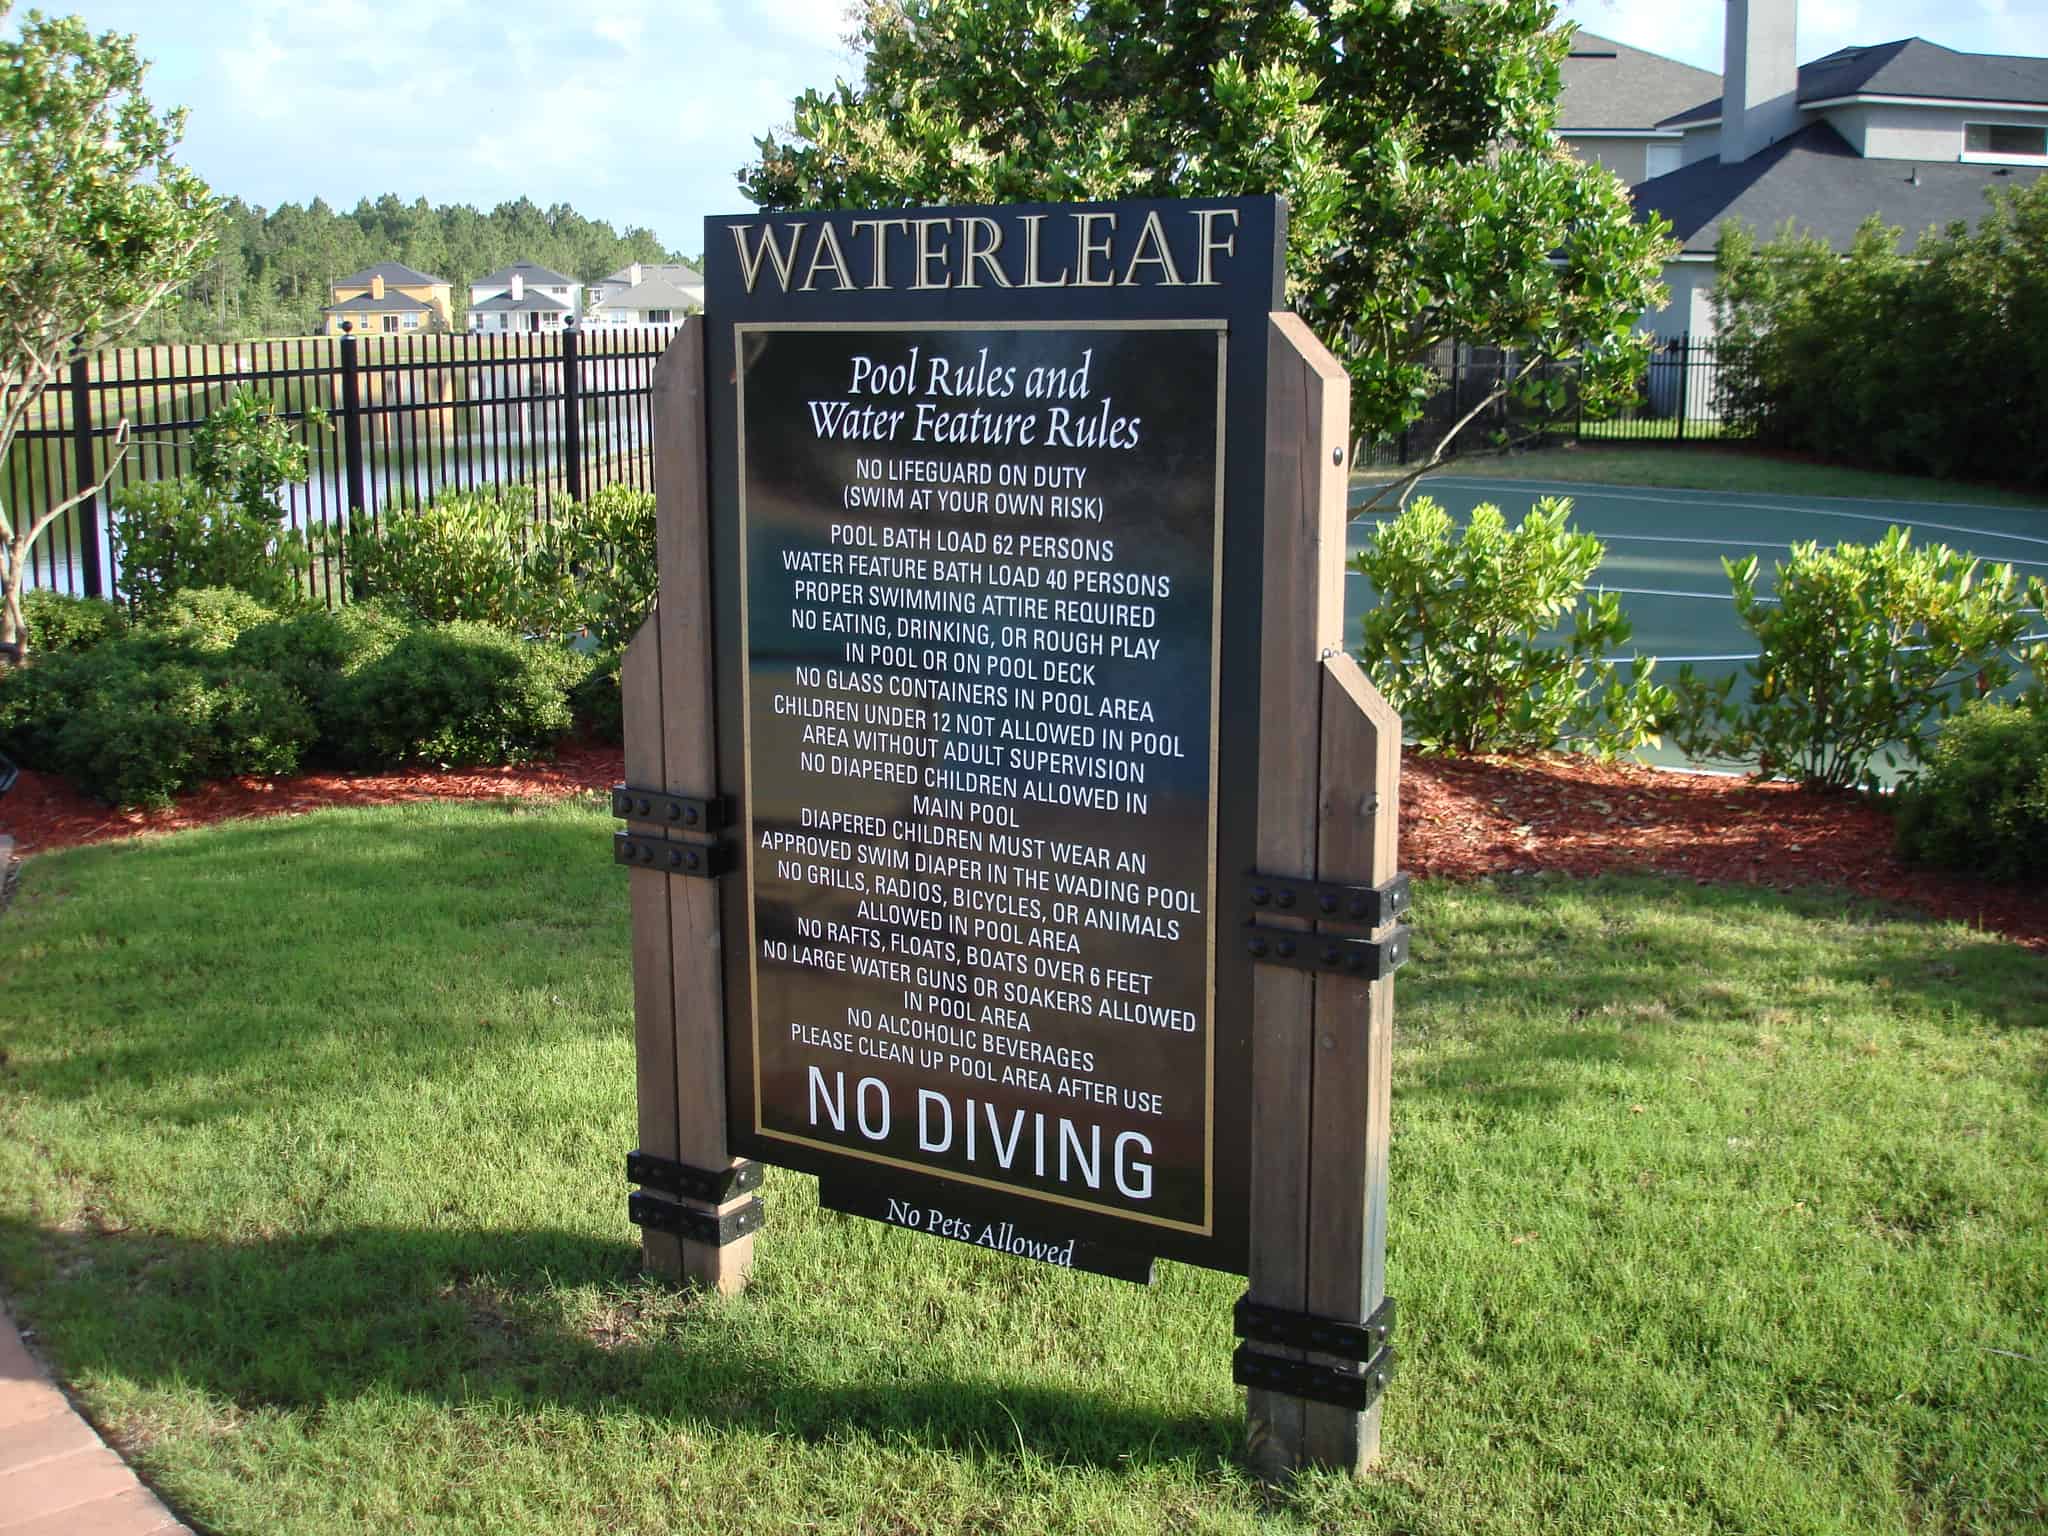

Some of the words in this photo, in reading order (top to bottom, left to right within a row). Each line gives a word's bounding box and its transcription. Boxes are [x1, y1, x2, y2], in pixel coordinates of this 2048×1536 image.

[729, 209, 1240, 293] WATERLEAF
[847, 345, 919, 396] Pool
[924, 346, 1017, 398] Rules
[1024, 347, 1093, 400] and
[807, 400, 905, 441] Water
[911, 403, 1036, 446] Feature
[1043, 396, 1141, 450] Rules
[856, 457, 882, 480] NO
[888, 459, 992, 485] LIFEGUARD
[998, 463, 1027, 487] ON
[1033, 465, 1087, 489] DUTY
[843, 484, 904, 509] (SWIM
[909, 488, 933, 510] AT
[936, 489, 989, 513] YOUR
[994, 492, 1044, 516] OWN
[1050, 495, 1104, 523] RISK)
[830, 523, 878, 547] POOL
[882, 526, 931, 550] BATH
[937, 529, 987, 554] LOAD
[992, 533, 1014, 556] 62
[1019, 534, 1114, 562] PERSONS
[781, 549, 844, 574] WATER
[848, 554, 927, 580] FEATURE
[933, 559, 982, 585] BATH
[988, 563, 1040, 588] LOAD
[1045, 568, 1067, 590] 40
[1073, 569, 1170, 598] PERSONS
[794, 579, 863, 605] PROPER
[868, 585, 976, 614] SWIMMING
[981, 594, 1049, 620] ATTIRE
[1054, 599, 1156, 628] REQUIRED
[791, 608, 817, 630] NO
[822, 610, 892, 640] EATING,
[897, 616, 995, 649] DRINKING,
[1001, 625, 1027, 649] OR
[1033, 628, 1103, 656] ROUGH
[1110, 635, 1161, 661] PLAY
[845, 641, 864, 663] IN
[870, 644, 918, 669] POOL
[922, 649, 947, 671] OR
[953, 651, 980, 675] ON
[986, 655, 1038, 681] POOL
[1043, 660, 1096, 686] DECK
[795, 665, 821, 688] NO
[826, 669, 883, 694] GLASS
[889, 675, 1008, 707] CONTAINERS
[1014, 687, 1035, 711] IN
[1041, 690, 1094, 717] POOL
[1098, 696, 1155, 723] AREA
[774, 694, 859, 722] CHILDREN
[864, 703, 926, 730] UNDER
[932, 711, 951, 733] 12
[956, 713, 996, 737] NOT
[999, 718, 1095, 748] ALLOWED
[1102, 727, 1123, 751] IN
[1130, 731, 1185, 758] POOL
[802, 723, 849, 748] AREA
[853, 729, 939, 759] WITHOUT
[943, 740, 1005, 767] ADULT
[1009, 747, 1145, 784] SUPERVISION
[800, 751, 825, 773] NO
[831, 755, 918, 785] DIAPERED
[924, 767, 1017, 798] CHILDREN
[1022, 779, 1119, 811] ALLOWED
[1126, 791, 1147, 815] IN
[913, 794, 963, 821] MAIN
[969, 801, 1020, 828] POOL
[801, 807, 886, 837] DIAPERED
[892, 820, 982, 852] CHILDREN
[989, 833, 1046, 860] MUST
[1049, 840, 1110, 870] WEAR
[1115, 850, 1146, 875] AN
[760, 830, 851, 861] APPROVED
[857, 844, 909, 871] SWIM
[915, 852, 982, 881] DIAPER
[987, 863, 1007, 885] IN
[1012, 866, 1050, 891] THE
[1054, 872, 1140, 904] WADING
[1146, 885, 1201, 914] POOL
[777, 859, 802, 881] NO
[807, 864, 870, 895] GRILLS,
[875, 874, 948, 908] RADIOS,
[953, 887, 1047, 924] BICYCLES,
[1052, 902, 1079, 926] OR
[1083, 907, 1180, 941] ANIMALS
[797, 916, 822, 939] NO
[827, 921, 886, 953] RAFTS,
[890, 932, 961, 966] FLOATS,
[966, 945, 1028, 974] BOATS
[1034, 956, 1084, 985] OVER
[1089, 967, 1101, 987] 6
[1106, 968, 1153, 995] FEET
[856, 899, 942, 931] ALLOWED
[948, 913, 968, 936] IN
[974, 918, 1024, 945] POOL
[1027, 927, 1081, 954] AREA
[763, 939, 787, 961] NO
[792, 944, 847, 972] LARGE
[849, 954, 911, 984] WATER
[916, 966, 967, 994] GUNS
[973, 976, 998, 1000] OR
[1003, 981, 1093, 1015] SOAKERS
[1097, 997, 1196, 1032] ALLOWED
[904, 990, 922, 1012] IN
[928, 994, 976, 1022] POOL
[979, 1004, 1031, 1033] AREA
[791, 1022, 854, 1053] PLEASE
[858, 1036, 914, 1065] CLEAN
[919, 1047, 944, 1070] UP
[949, 1053, 998, 1082] POOL
[1001, 1065, 1053, 1093] AREA
[1056, 1076, 1118, 1106] AFTER
[1123, 1088, 1163, 1115] USE
[847, 1007, 872, 1029] NO
[877, 1013, 977, 1050] ALCOHOLIC
[982, 1032, 1094, 1072] BEVERAGES
[808, 1065, 890, 1141] NO
[918, 1087, 1153, 1199] DIVING
[886, 1198, 920, 1226] No
[926, 1209, 972, 1240] Pets
[976, 1222, 1074, 1267] Allowed
